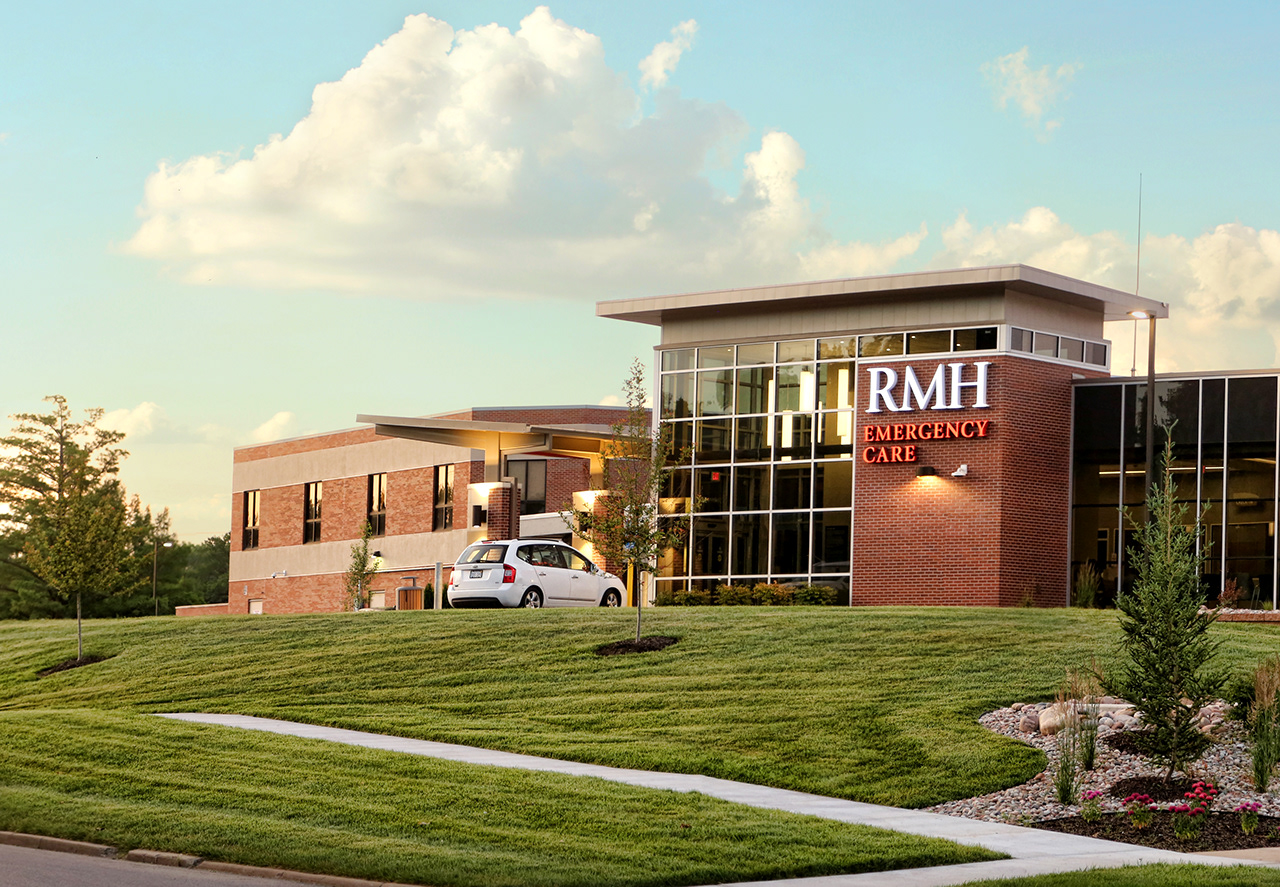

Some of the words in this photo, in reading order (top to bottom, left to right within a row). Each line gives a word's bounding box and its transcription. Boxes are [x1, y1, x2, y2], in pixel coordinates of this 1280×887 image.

[865, 361, 992, 413] RMH
[863, 420, 989, 442] EMERGENCY
[862, 445, 917, 463] CARE
